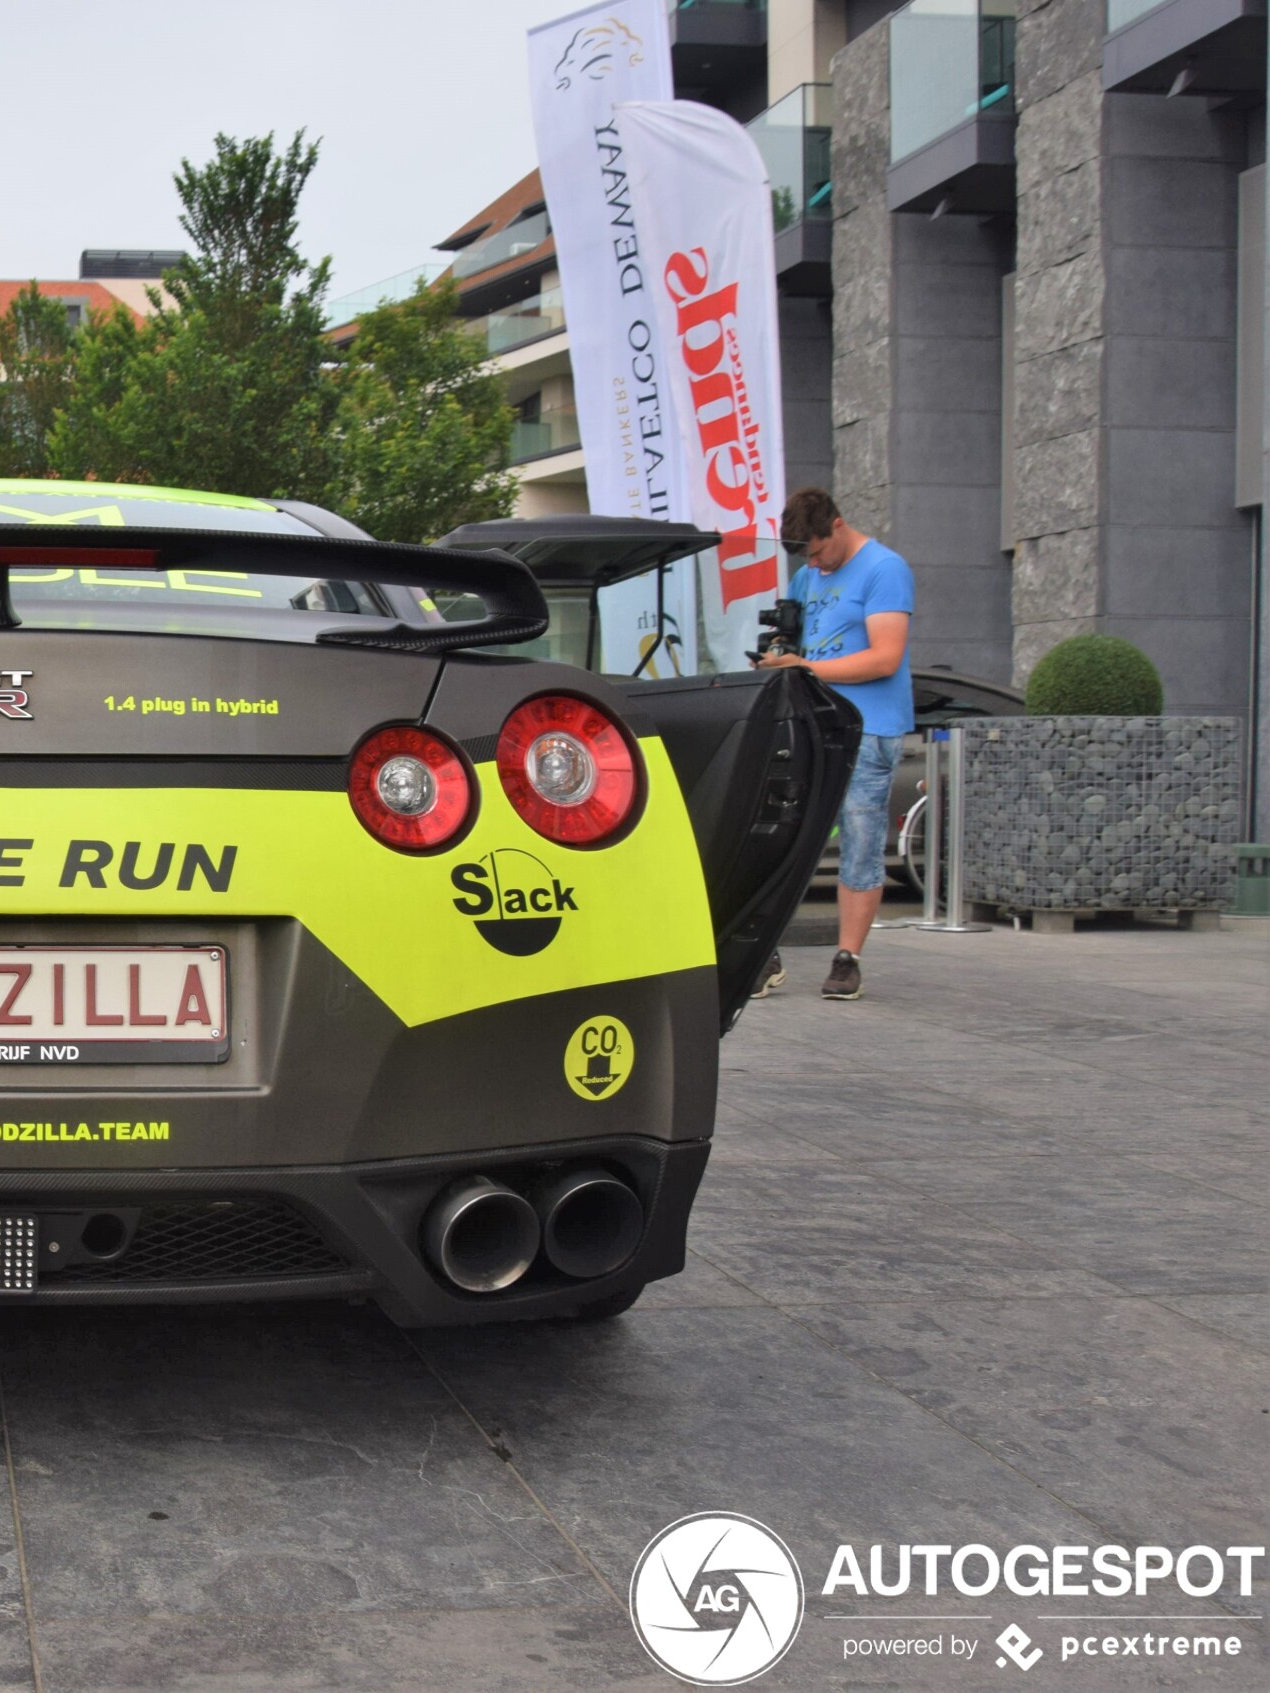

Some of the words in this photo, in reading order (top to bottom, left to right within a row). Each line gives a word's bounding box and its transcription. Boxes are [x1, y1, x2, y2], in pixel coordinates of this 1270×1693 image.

[104, 694, 137, 712] 1.4
[140, 695, 186, 717] plug
[189, 696, 211, 714] in
[215, 697, 279, 719] hybrid
[59, 838, 238, 893] RUN
[40, 1045, 80, 1061] NVD
